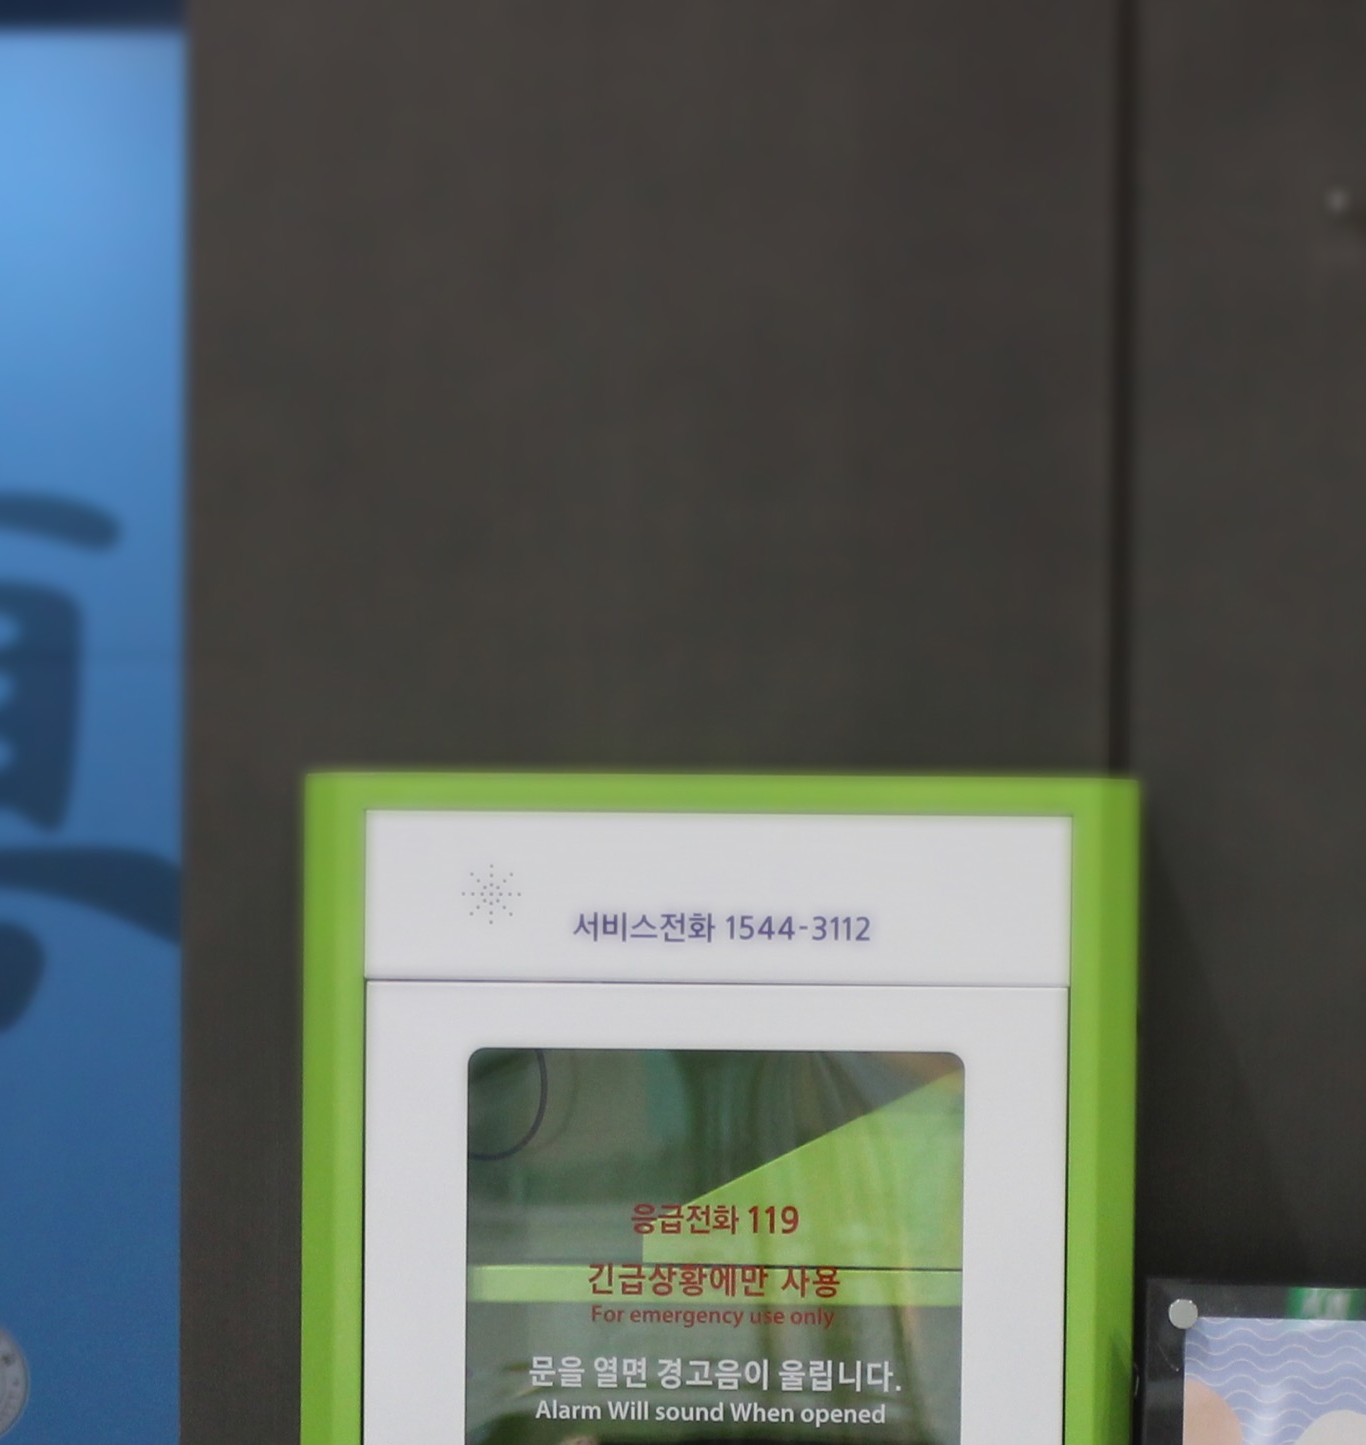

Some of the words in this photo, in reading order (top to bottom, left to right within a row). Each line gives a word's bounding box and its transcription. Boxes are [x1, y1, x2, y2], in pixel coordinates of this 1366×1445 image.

[573, 913, 715, 944] 서비스전화
[725, 915, 871, 943] 1544-3112
[632, 1204, 739, 1234] 응급전화
[749, 1206, 799, 1234] 119
[588, 1263, 767, 1297] 긴급상황에만
[781, 1267, 840, 1298] 사용
[592, 1306, 623, 1322] For
[630, 1311, 743, 1328] emergency
[750, 1312, 784, 1324] use
[791, 1308, 834, 1329] only
[529, 1356, 584, 1388] 문을
[594, 1357, 646, 1388] 열면
[657, 1358, 768, 1391] 경고음이
[779, 1359, 901, 1392] 울립니다.
[536, 1401, 601, 1420] Alarm
[607, 1401, 649, 1421] Will
[656, 1402, 724, 1422] sound
[731, 1404, 794, 1422] When
[801, 1404, 885, 1428] opened
